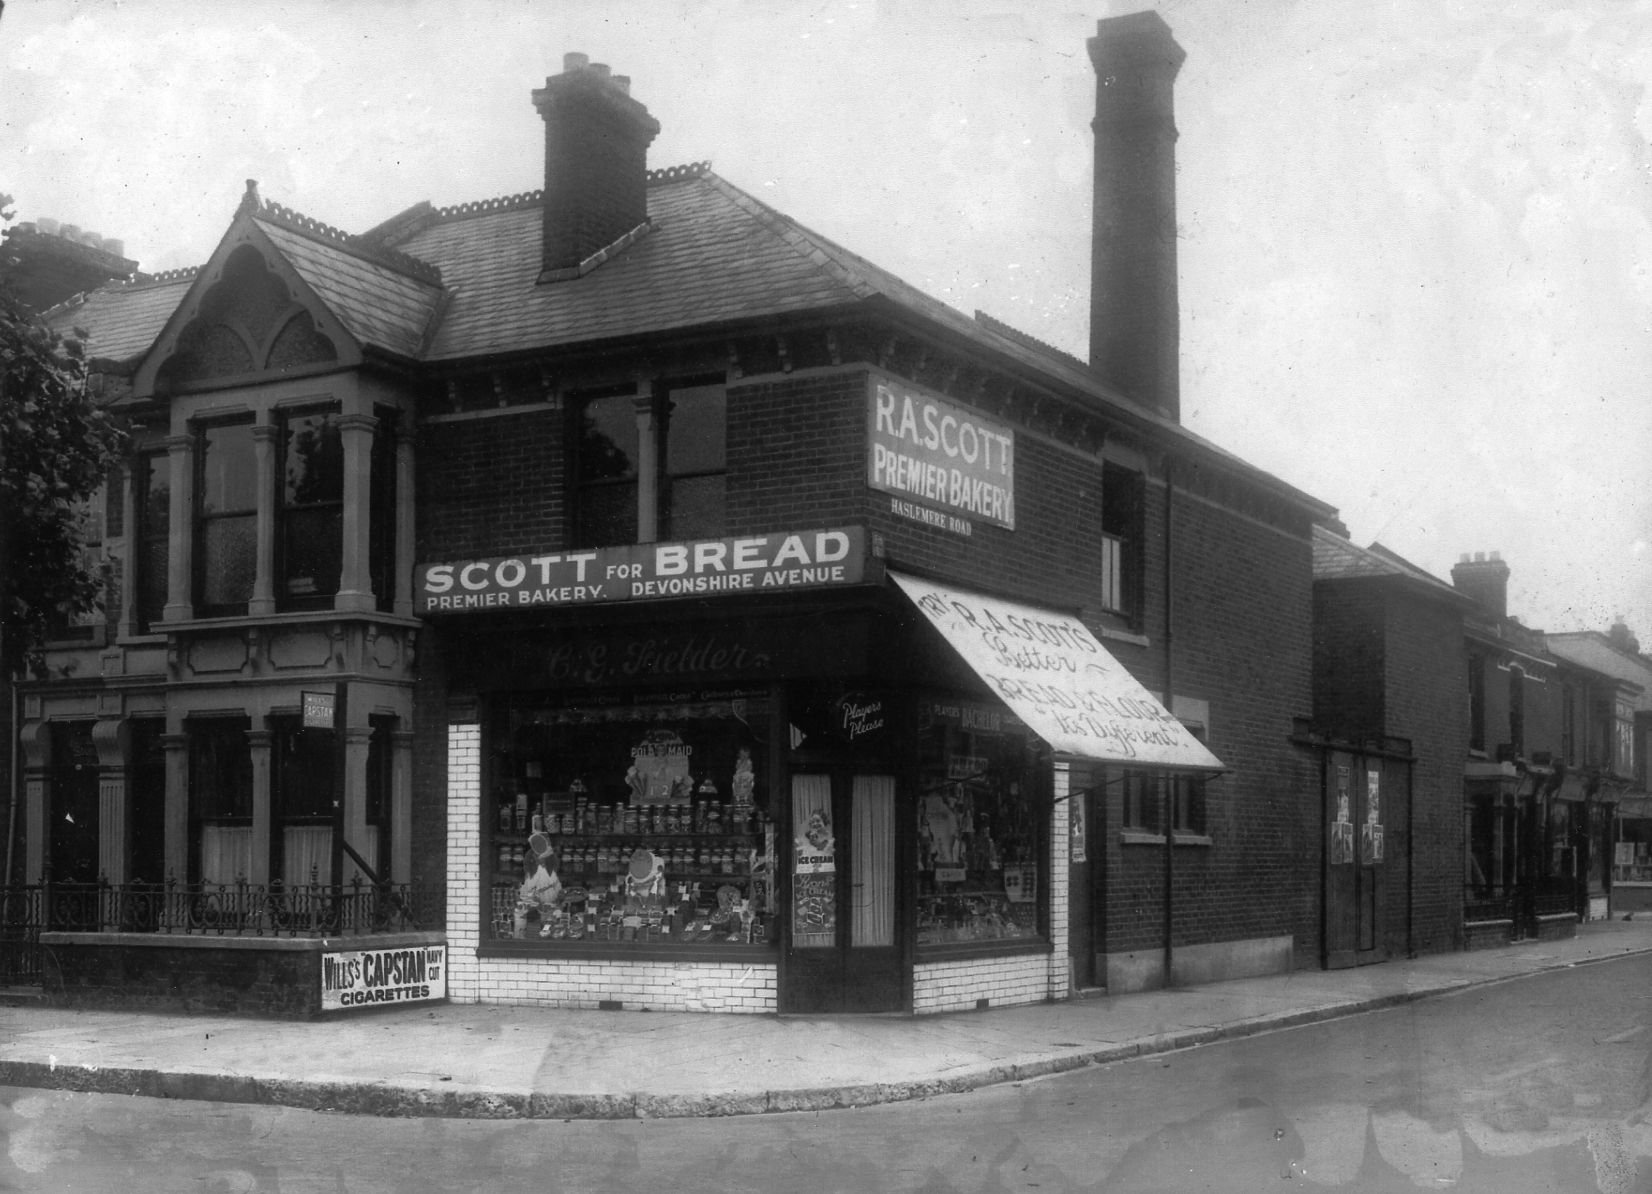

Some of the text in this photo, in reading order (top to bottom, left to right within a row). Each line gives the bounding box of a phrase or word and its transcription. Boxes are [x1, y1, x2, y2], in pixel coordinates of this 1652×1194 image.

[874, 442, 946, 504] PREMIER
[891, 497, 972, 537] HASLEMERE ROAD
[423, 531, 850, 594] SCOTT FOR BREAD
[427, 592, 511, 611] PREMIER
[631, 573, 754, 597] DEVONSHIRE
[761, 565, 845, 587] AVENUE
[985, 673, 1076, 710] BREAD
[849, 718, 884, 741] Please
[426, 950, 443, 964] NAVY
[428, 966, 441, 981] CUT
[340, 985, 431, 1006] CIGARETTES
